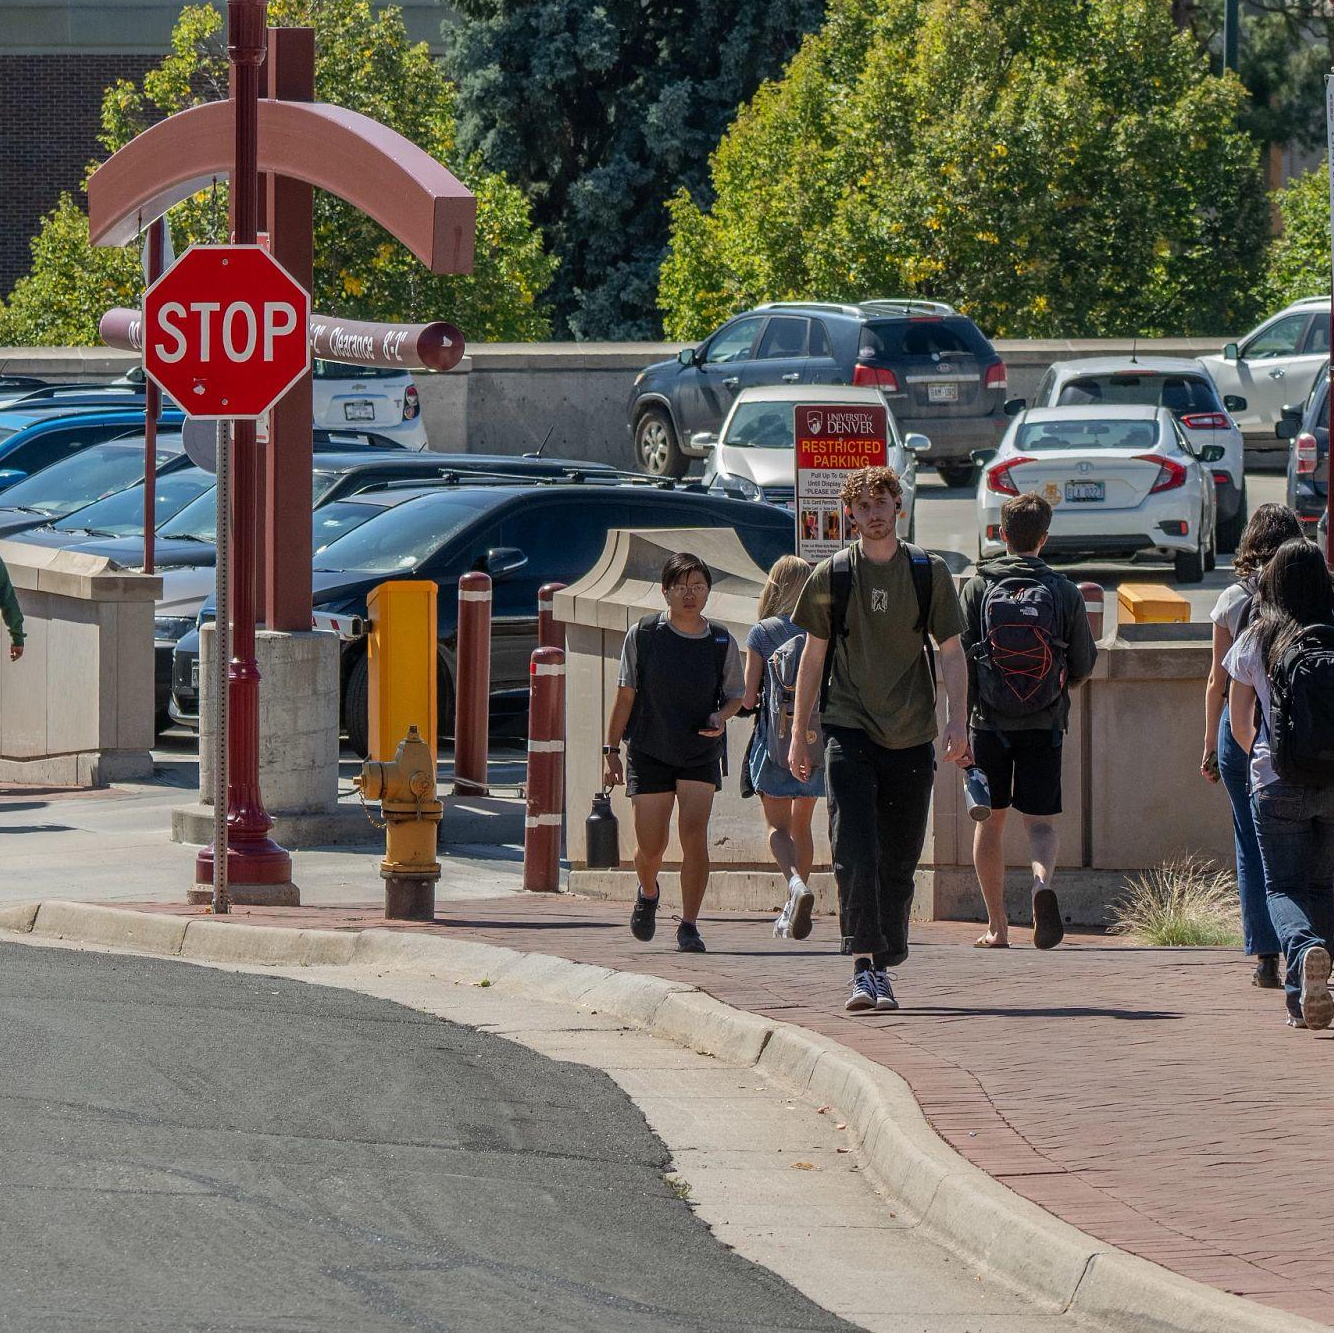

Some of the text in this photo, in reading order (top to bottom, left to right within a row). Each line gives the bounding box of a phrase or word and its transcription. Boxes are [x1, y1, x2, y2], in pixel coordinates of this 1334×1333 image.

[155, 301, 297, 363] STOP
[329, 326, 375, 360] Clearance
[827, 413, 868, 422] UNIVERSITY
[827, 422, 875, 434] DENVER
[802, 440, 881, 454] RESTRICTED
[813, 455, 870, 467] PARKING
